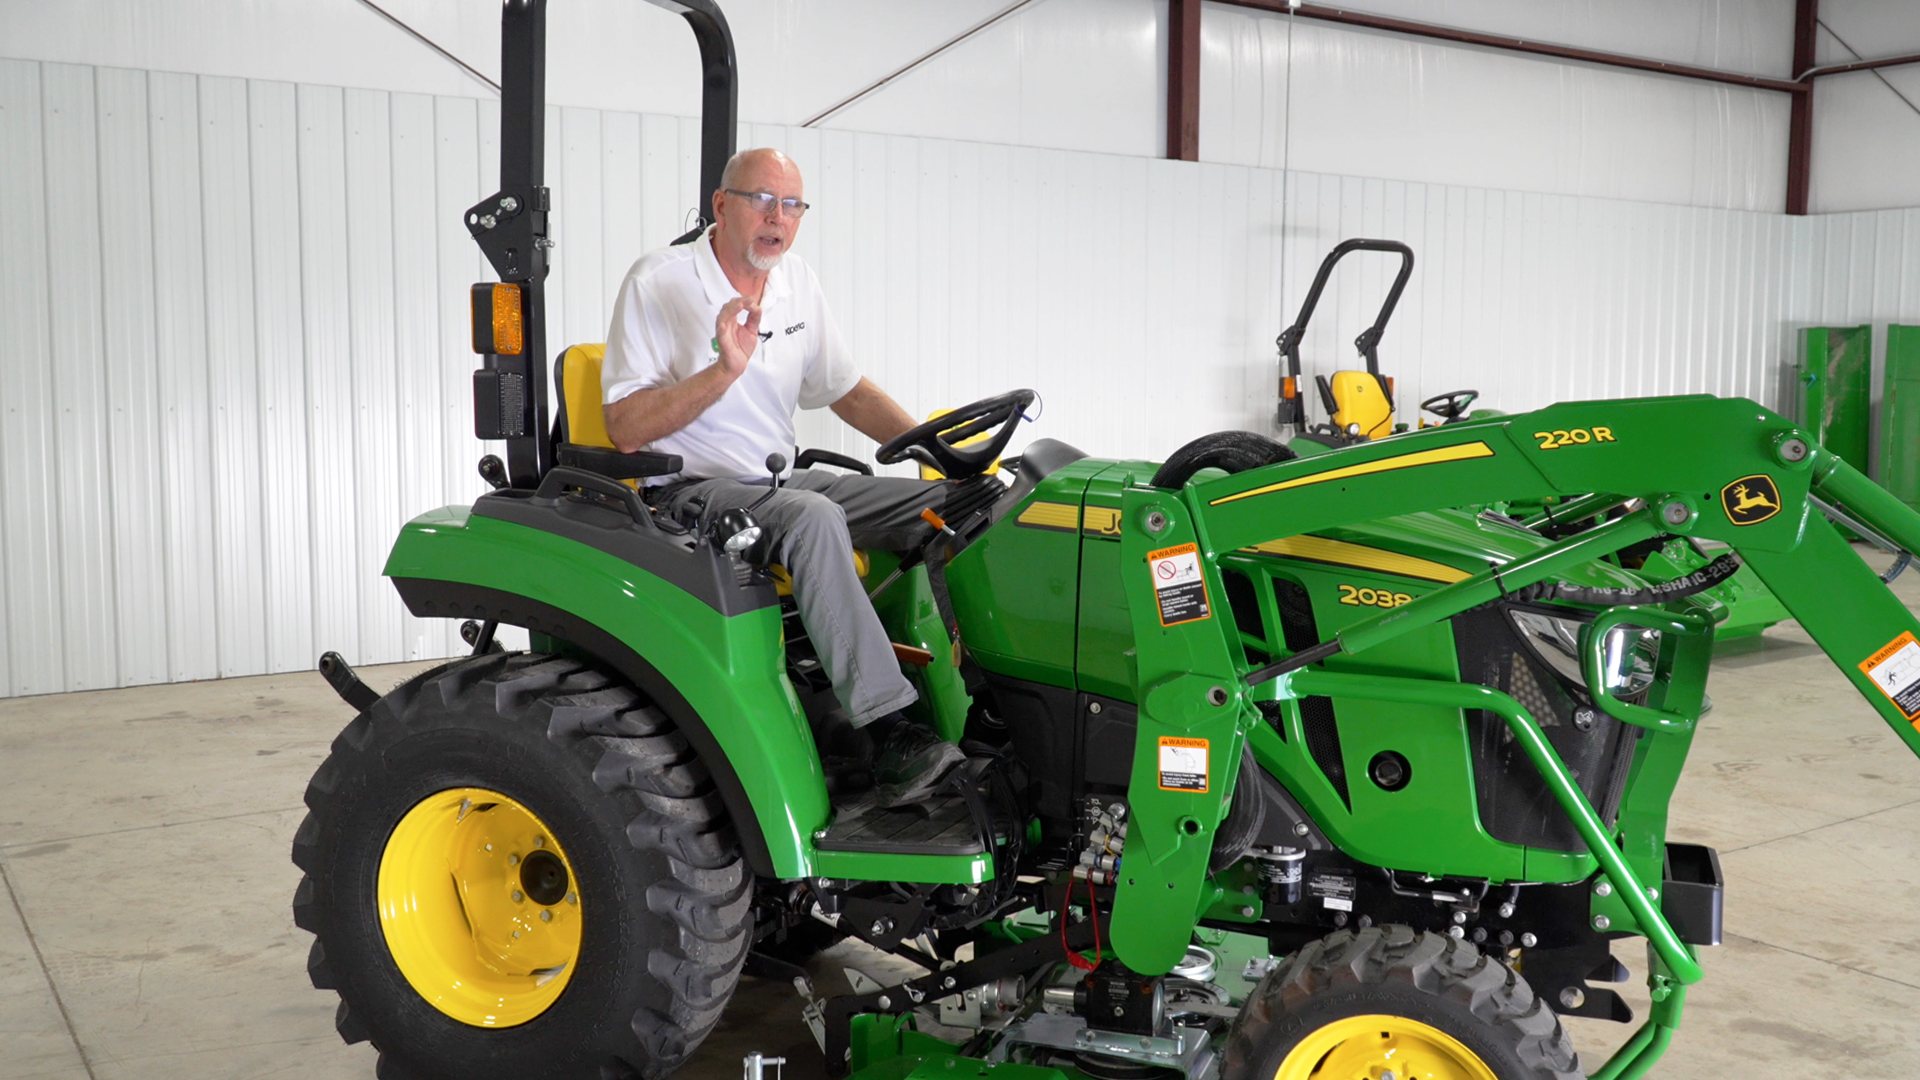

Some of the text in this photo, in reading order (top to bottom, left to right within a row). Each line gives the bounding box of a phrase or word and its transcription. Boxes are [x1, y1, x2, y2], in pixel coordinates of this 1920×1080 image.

[1157, 544, 1195, 558] WARNING
[1873, 637, 1908, 662] WARNING
[1168, 738, 1206, 747] WARNING
